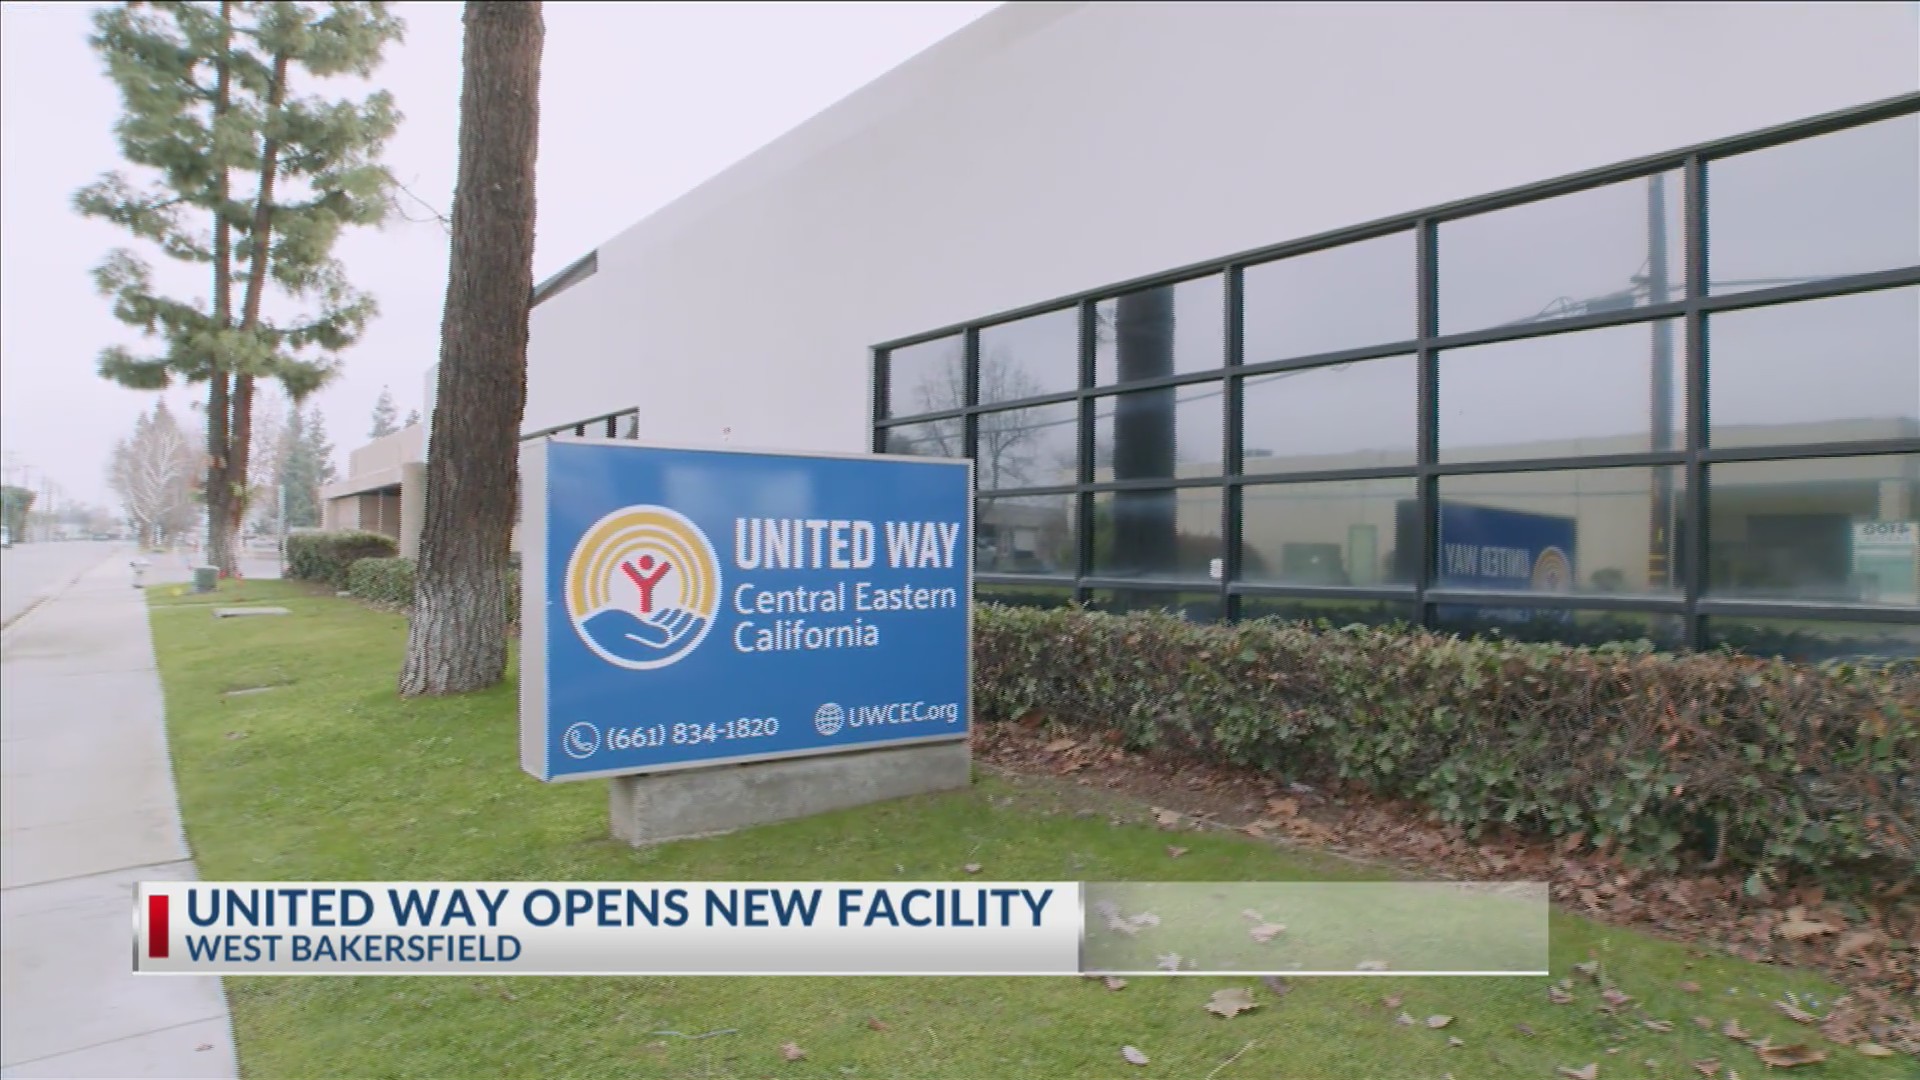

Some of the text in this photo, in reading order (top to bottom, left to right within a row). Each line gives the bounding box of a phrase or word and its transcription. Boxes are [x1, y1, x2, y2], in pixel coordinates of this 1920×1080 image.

[734, 517, 961, 570] UNITED WAY
[733, 582, 957, 615] Central Eastern
[733, 618, 879, 653] California
[848, 701, 958, 728] UWCEC.org
[606, 717, 779, 751] (661) 834-1820
